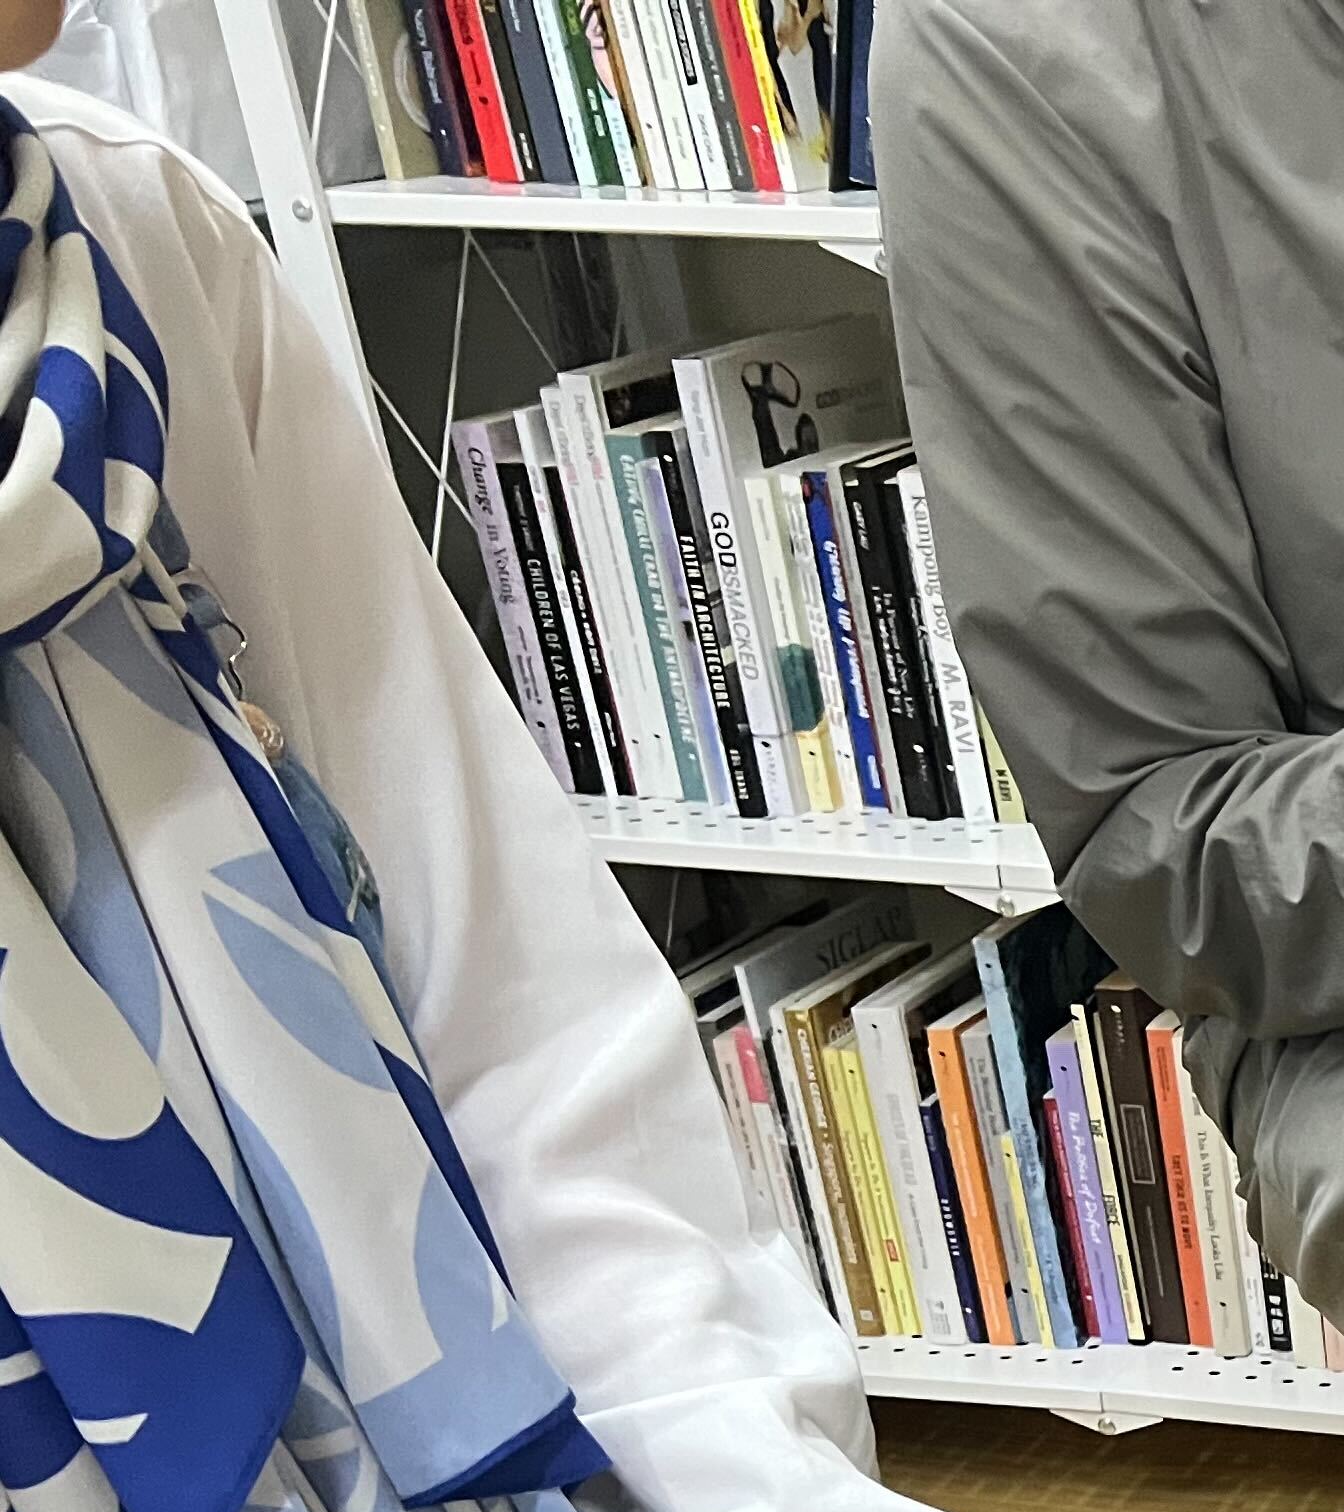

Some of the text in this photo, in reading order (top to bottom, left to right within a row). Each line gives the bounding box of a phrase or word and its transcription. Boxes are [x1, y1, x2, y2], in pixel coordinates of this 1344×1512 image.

[466, 446, 516, 605] Change in Voting
[909, 493, 954, 643] Kampong Boy
[526, 557, 580, 731] CHILDREN OF LAS VEGAS
[677, 533, 730, 710] FAITH IN ARCHITECTURE
[940, 660, 975, 754] M. RAVI
[1066, 1110, 1082, 1130] The
[1196, 1131, 1208, 1150] This
[1199, 1162, 1213, 1187] What
[1200, 1188, 1219, 1232] Inequality
[1208, 1234, 1223, 1261] Looks
